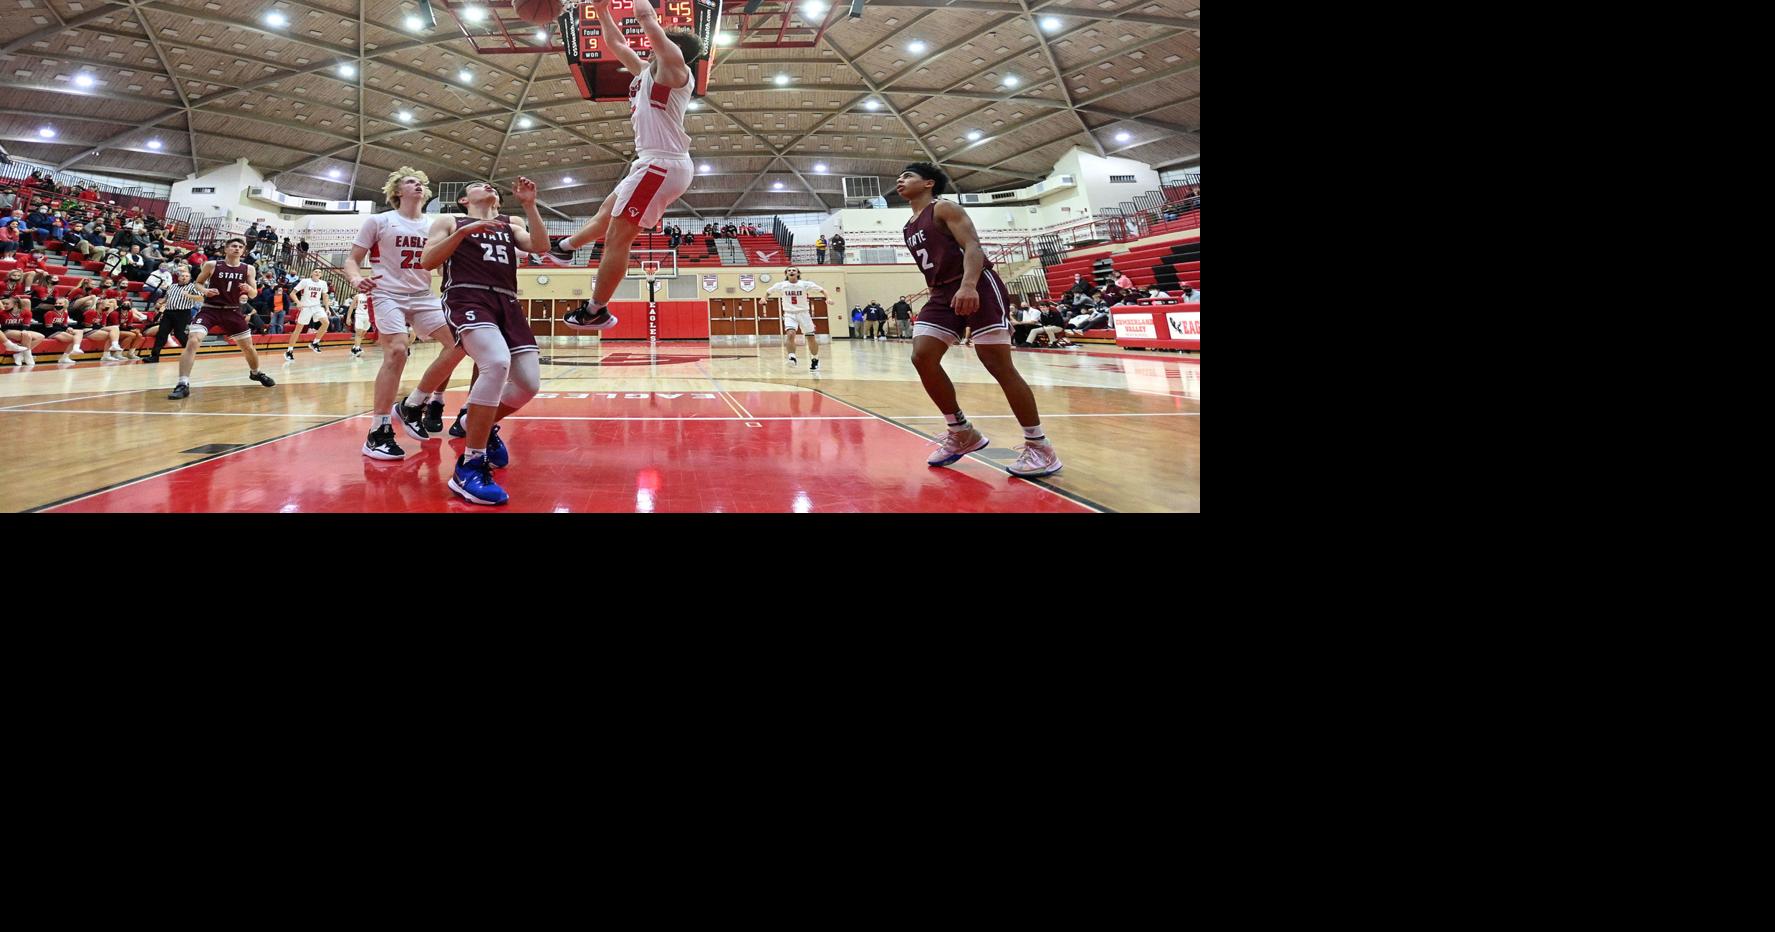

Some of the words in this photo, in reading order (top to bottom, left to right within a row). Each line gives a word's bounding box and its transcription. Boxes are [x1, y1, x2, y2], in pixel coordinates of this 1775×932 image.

[585, 5, 599, 19] 6
[669, 2, 691, 16] 45
[589, 38, 598, 49] 9
[395, 235, 428, 248] EAGLE
[400, 250, 423, 269] 23
[480, 242, 509, 264] 25
[916, 248, 934, 270] 2
[218, 272, 244, 280] STATE
[226, 281, 233, 292] 1
[466, 310, 476, 321] S
